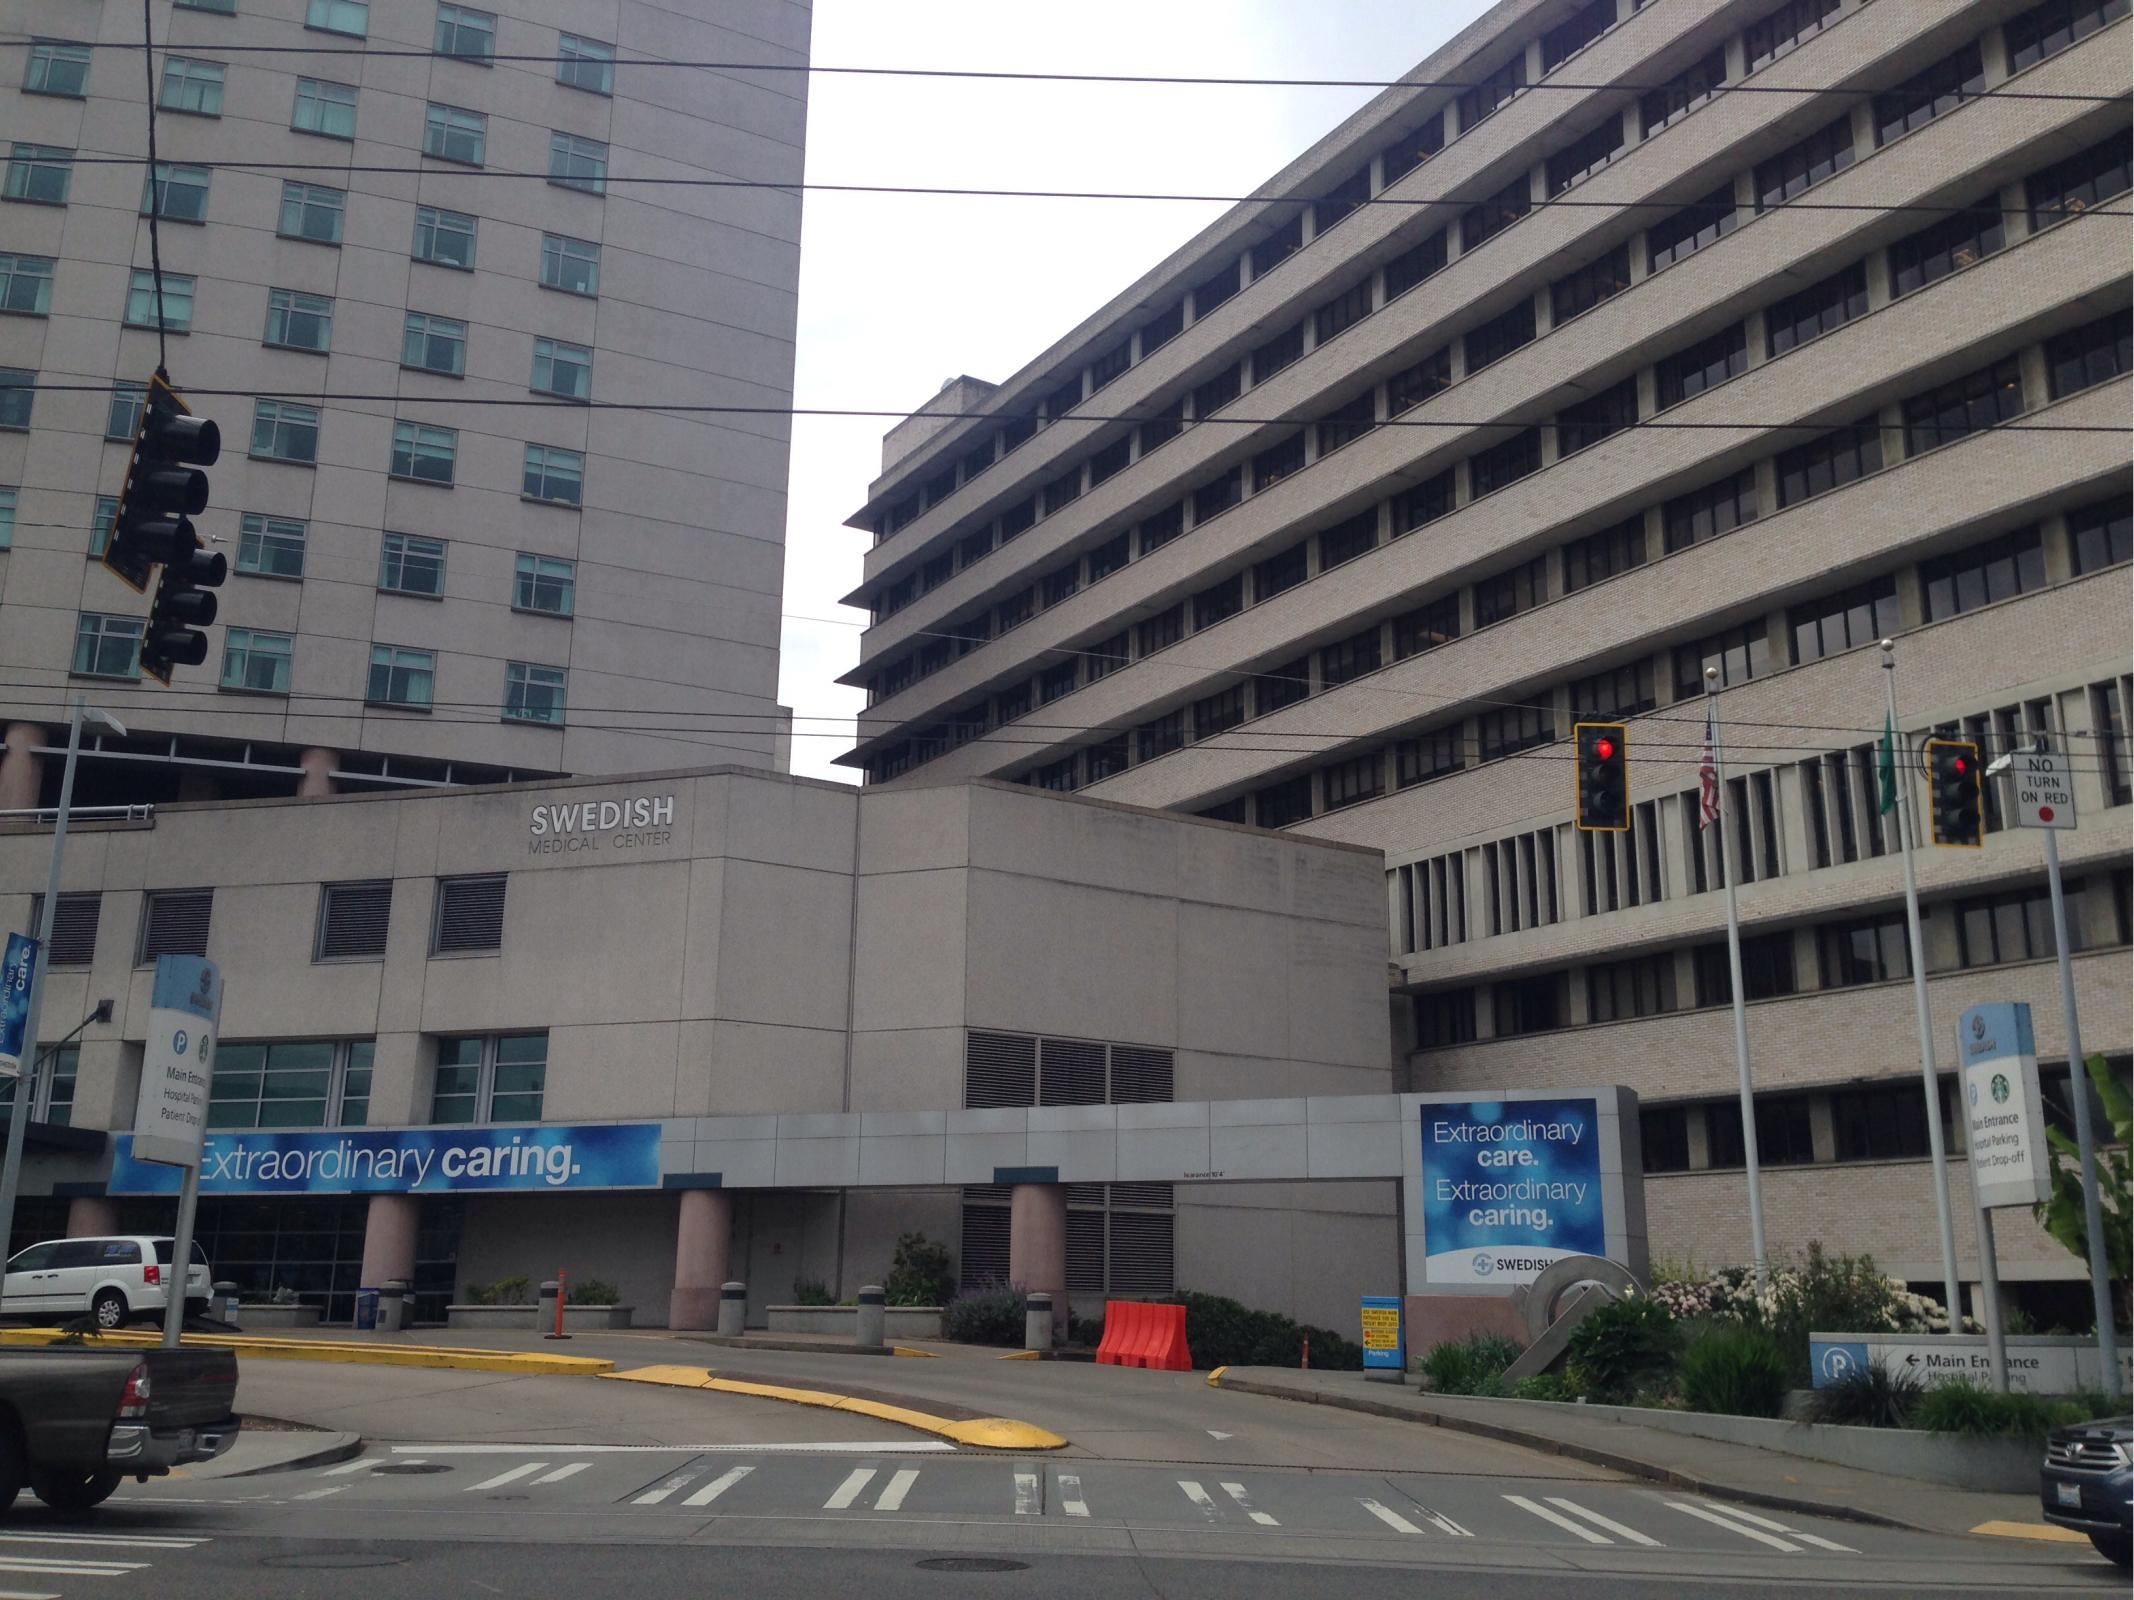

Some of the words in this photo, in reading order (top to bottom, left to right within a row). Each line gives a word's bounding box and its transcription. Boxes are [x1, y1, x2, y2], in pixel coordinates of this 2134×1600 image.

[2028, 758, 2053, 773] NO
[2026, 775, 2060, 788] TURN
[2021, 790, 2038, 803] ON
[2044, 792, 2068, 804] RED
[529, 795, 675, 836] SWEDISH
[528, 837, 599, 855] MEDICAL
[612, 832, 671, 848] CENTER
[16, 944, 32, 991] care.
[166, 1066, 187, 1082] Main
[163, 1087, 191, 1106] Hospital
[161, 1107, 186, 1123] Patient
[1983, 1111, 2019, 1128] Entrance
[1434, 1119, 1584, 1145] Extraordinary
[1991, 1132, 2019, 1148] Parking
[199, 1139, 436, 1189] Extraordinary
[441, 1136, 581, 1185] caring.
[1477, 1149, 1539, 1168] care.
[1992, 1150, 2025, 1167] Drop-off
[1436, 1177, 1586, 1205] Extraordinary
[1469, 1204, 1554, 1231] caring.
[1926, 1354, 1966, 1367] Main
[1971, 1355, 2040, 1369] Enance
